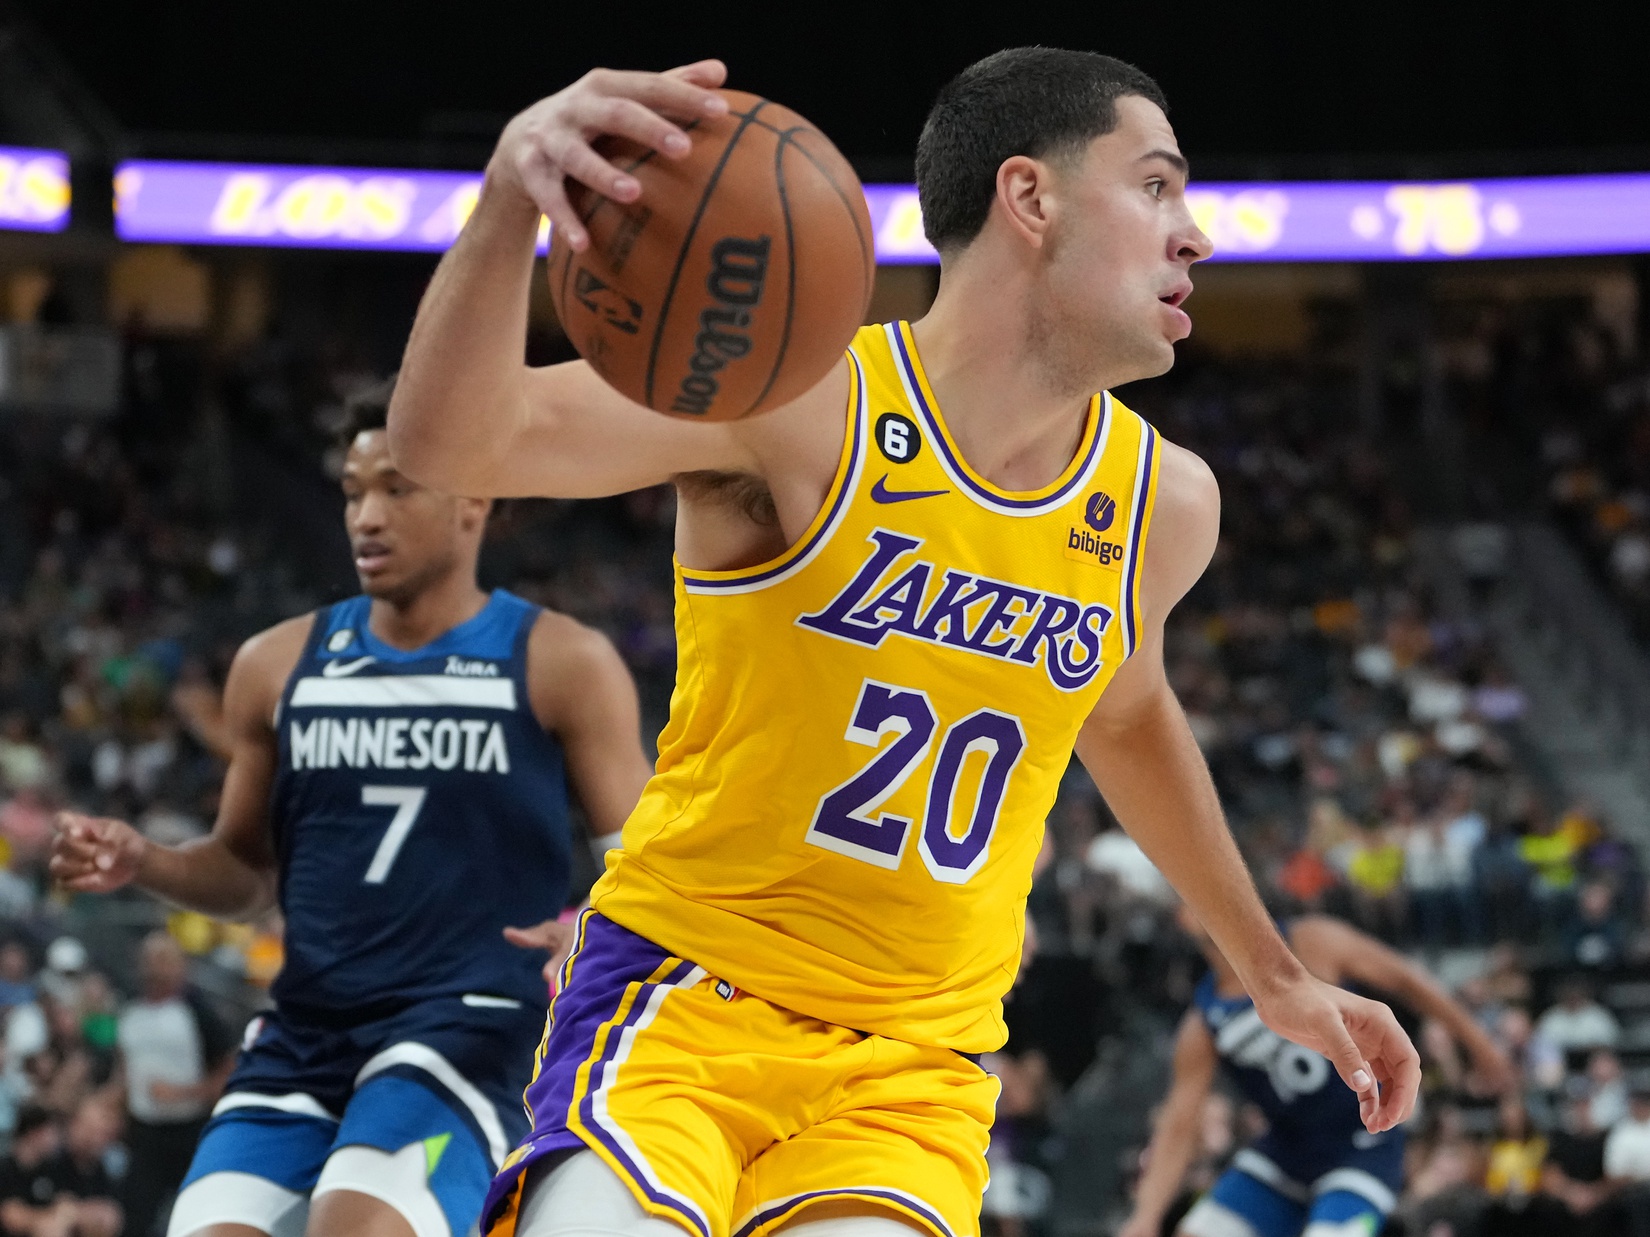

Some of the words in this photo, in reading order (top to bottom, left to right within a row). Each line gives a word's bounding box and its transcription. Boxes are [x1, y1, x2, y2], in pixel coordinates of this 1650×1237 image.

[210, 173, 415, 241] LOS
[670, 233, 773, 415] Wilson
[883, 418, 910, 459] 6
[1067, 527, 1124, 565] bibigo
[794, 526, 1115, 693] LAKERS
[290, 716, 510, 775] MINNESOTA
[804, 676, 1029, 885] 20
[361, 784, 428, 884] 7
